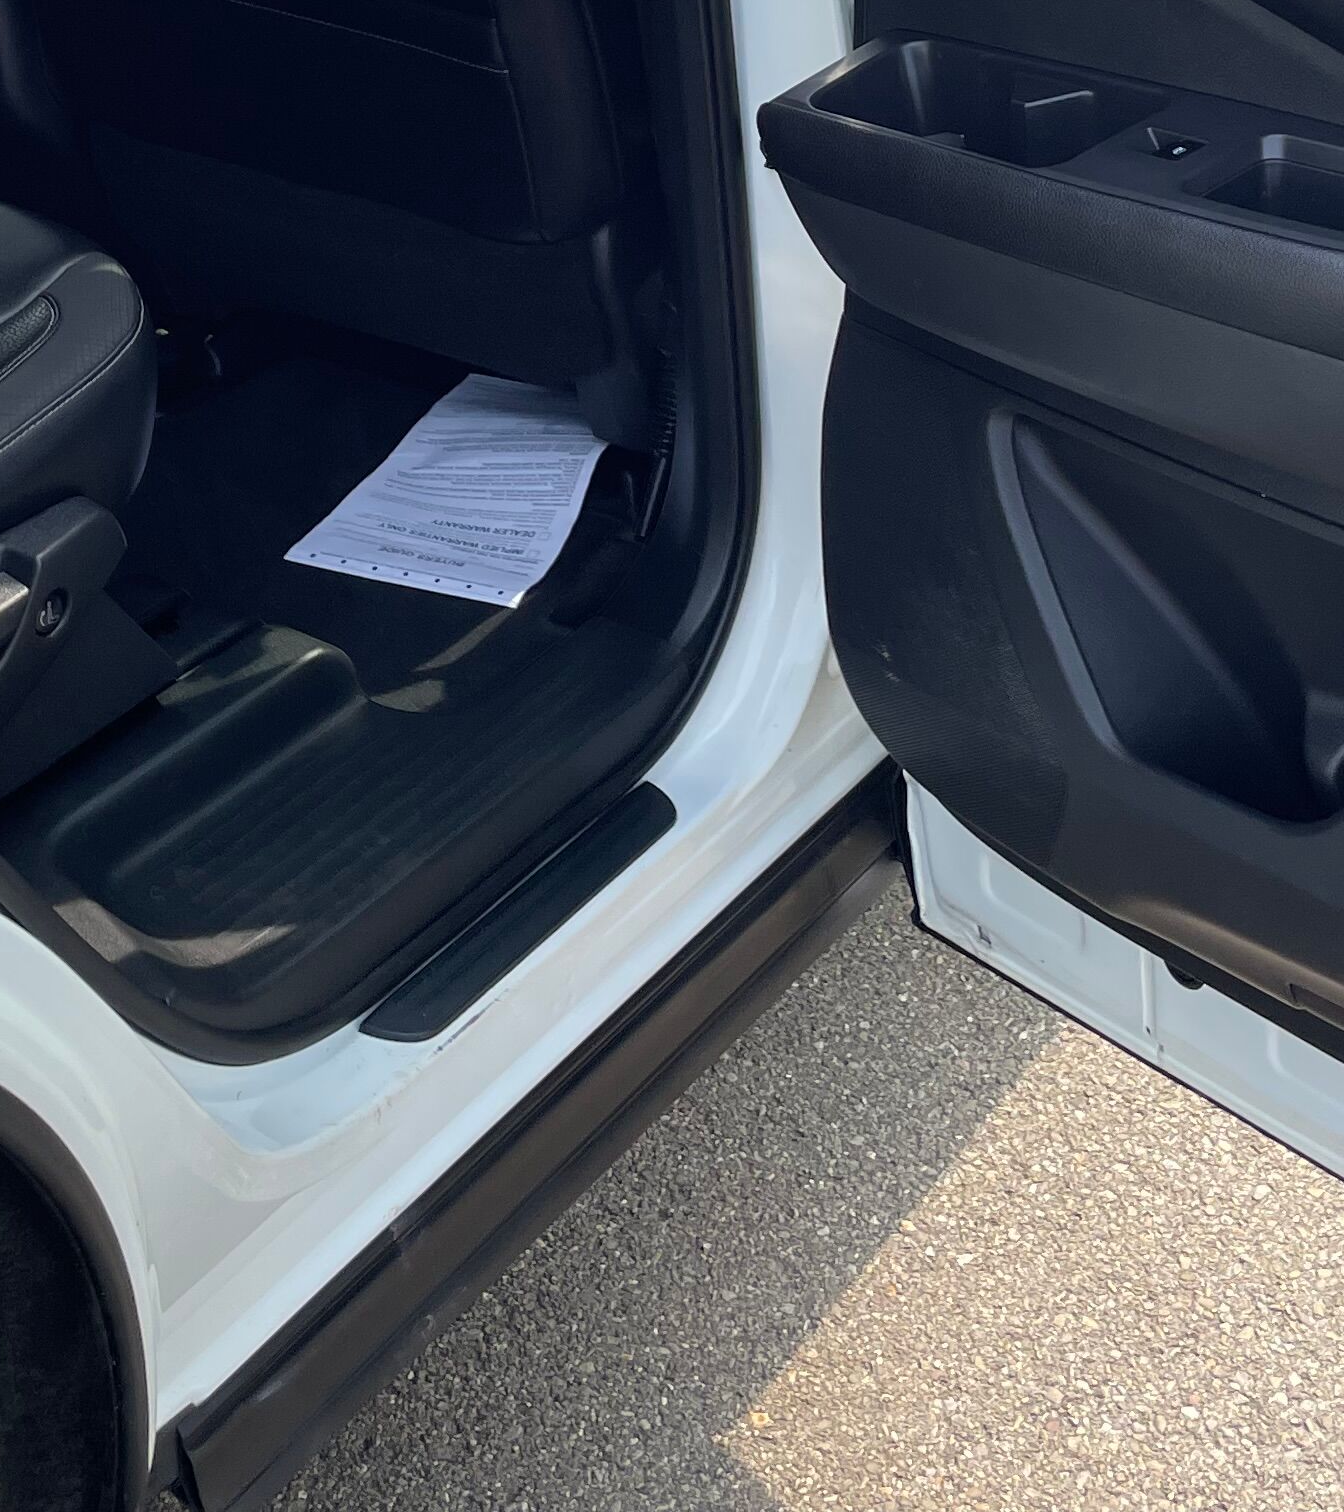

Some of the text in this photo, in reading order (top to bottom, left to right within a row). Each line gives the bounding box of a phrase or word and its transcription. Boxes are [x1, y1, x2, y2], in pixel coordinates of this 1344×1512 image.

[432, 520, 536, 538] DEALER WARRANTY
[409, 530, 478, 548] WARRANTIES
[482, 545, 523, 555] IMPLIED
